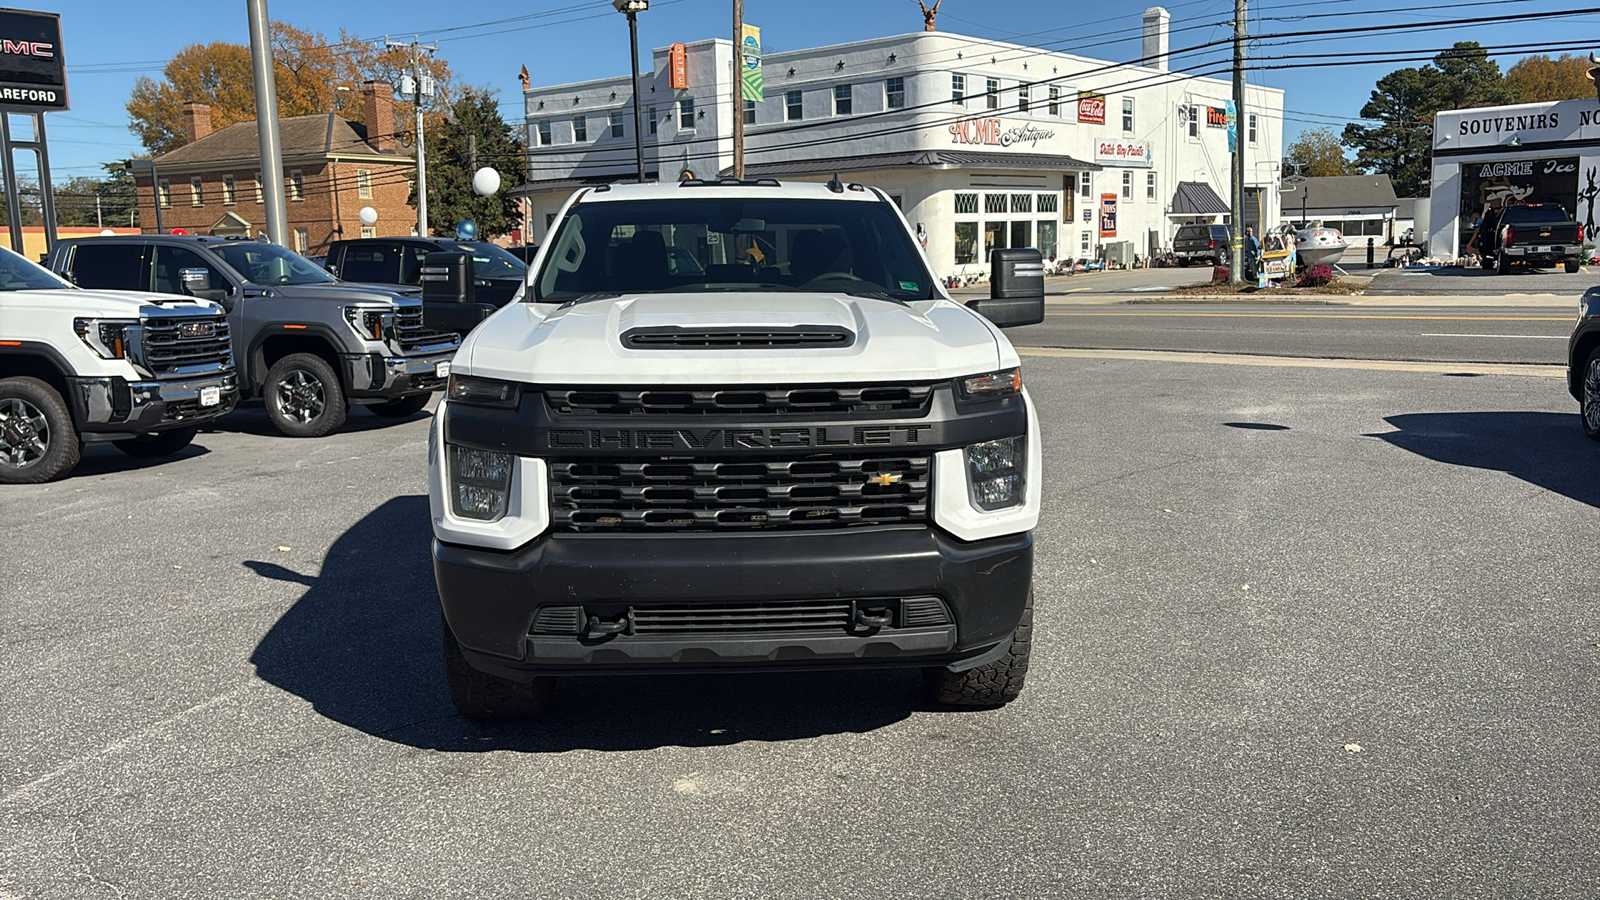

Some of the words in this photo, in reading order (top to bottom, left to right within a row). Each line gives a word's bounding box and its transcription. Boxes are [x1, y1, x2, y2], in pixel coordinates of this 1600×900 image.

[0, 39, 54, 57] MC
[676, 46, 684, 85] ACME
[949, 117, 1001, 146] ACME
[1460, 113, 1559, 136] SOUVENIRS
[1100, 143, 1115, 155] Dutch
[1117, 144, 1127, 158] Boy
[1127, 144, 1144, 157] Paints
[1480, 162, 1533, 178] ACME
[1543, 160, 1576, 174] Ice
[1103, 218, 1115, 229] TEA
[708, 234, 719, 243] 25
[547, 425, 932, 449] CHEVROLET
